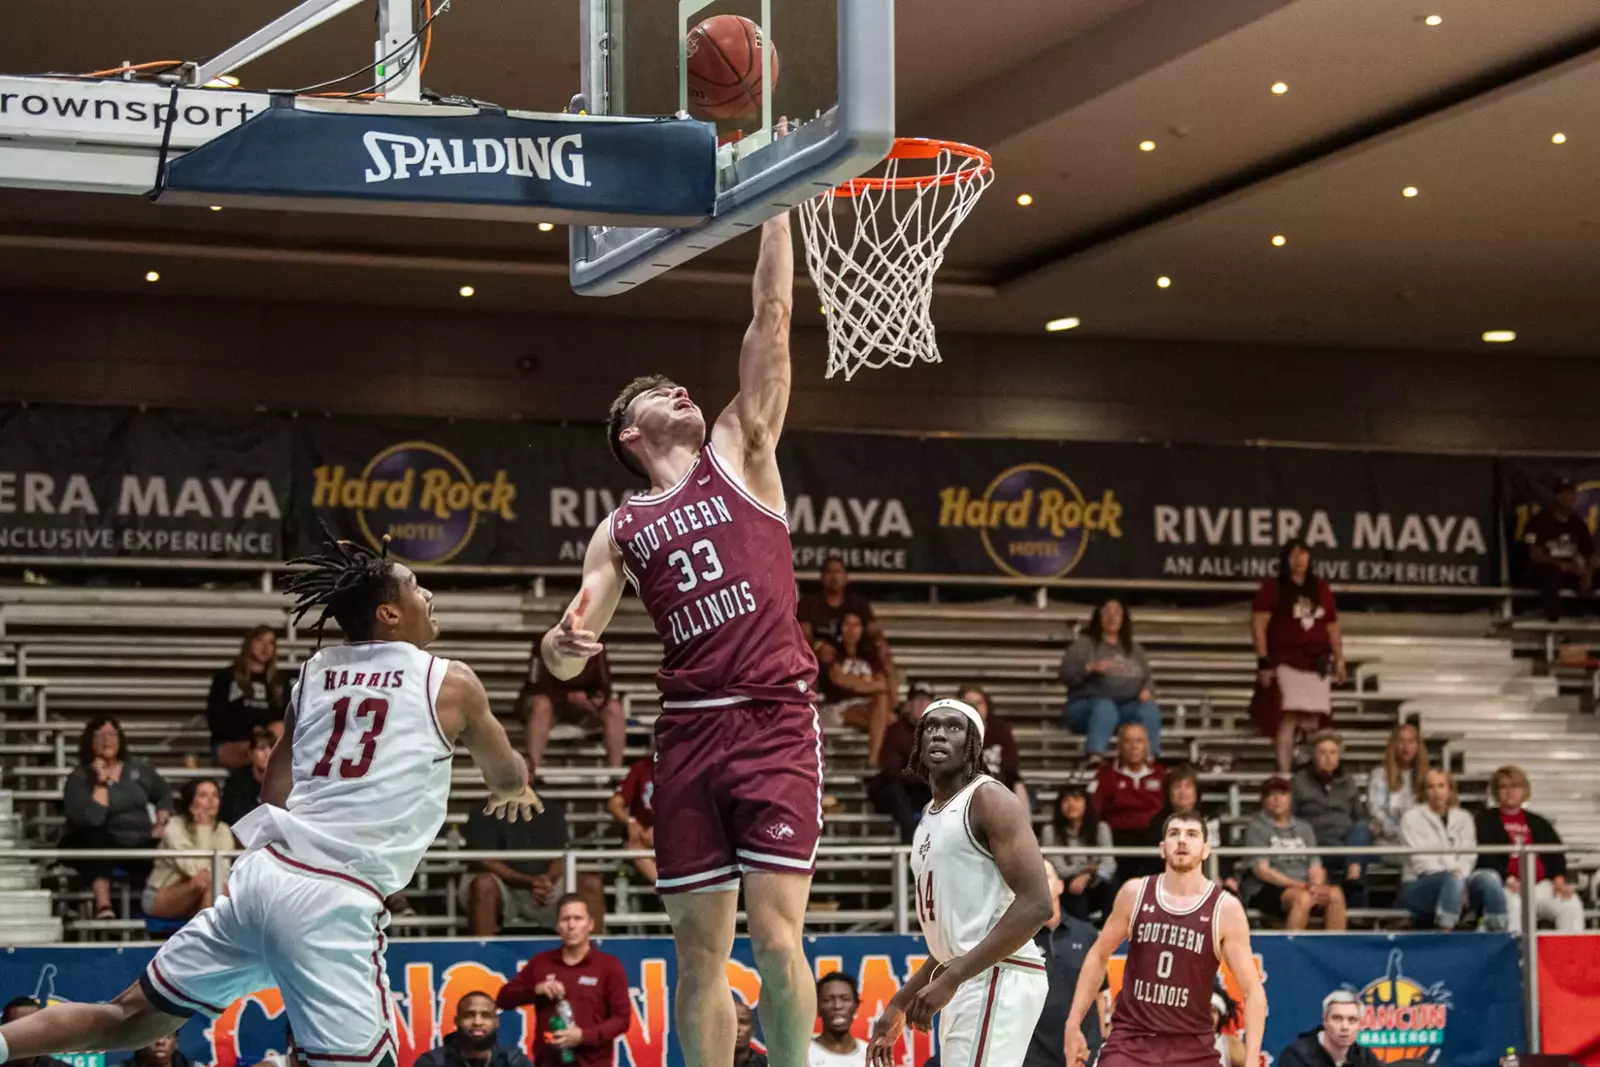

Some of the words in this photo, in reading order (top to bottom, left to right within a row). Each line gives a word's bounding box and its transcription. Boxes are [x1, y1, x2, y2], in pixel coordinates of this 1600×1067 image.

[363, 130, 586, 188] SPALDING
[118, 474, 281, 519] MAYA
[312, 464, 415, 510] Hard
[420, 469, 517, 521] Rock
[939, 486, 1033, 529] Hard
[1038, 489, 1123, 538] Rock
[388, 523, 446, 542] HOTEL
[628, 495, 733, 570] SOUTHERN
[788, 494, 914, 538] MAYA
[1154, 504, 1338, 549] RIVIERA
[1352, 510, 1487, 555] MAYA
[122, 528, 274, 553] EXPERIENCE
[1009, 541, 1059, 557] HOTEL
[667, 538, 724, 593] 33
[1163, 556, 1194, 576] AN
[1357, 560, 1480, 585] EXPERIENCE
[668, 581, 757, 645] ILLINOIS
[323, 670, 404, 692] HARRIS
[311, 696, 389, 779] 13
[916, 870, 936, 924] 14
[1136, 922, 1205, 955] SOUTHERN
[1156, 951, 1174, 979] 0
[1133, 978, 1190, 1008] ILLINOIS
[1360, 1003, 1447, 1030] ANCUN
[1360, 1031, 1438, 1045] HALLENGE
